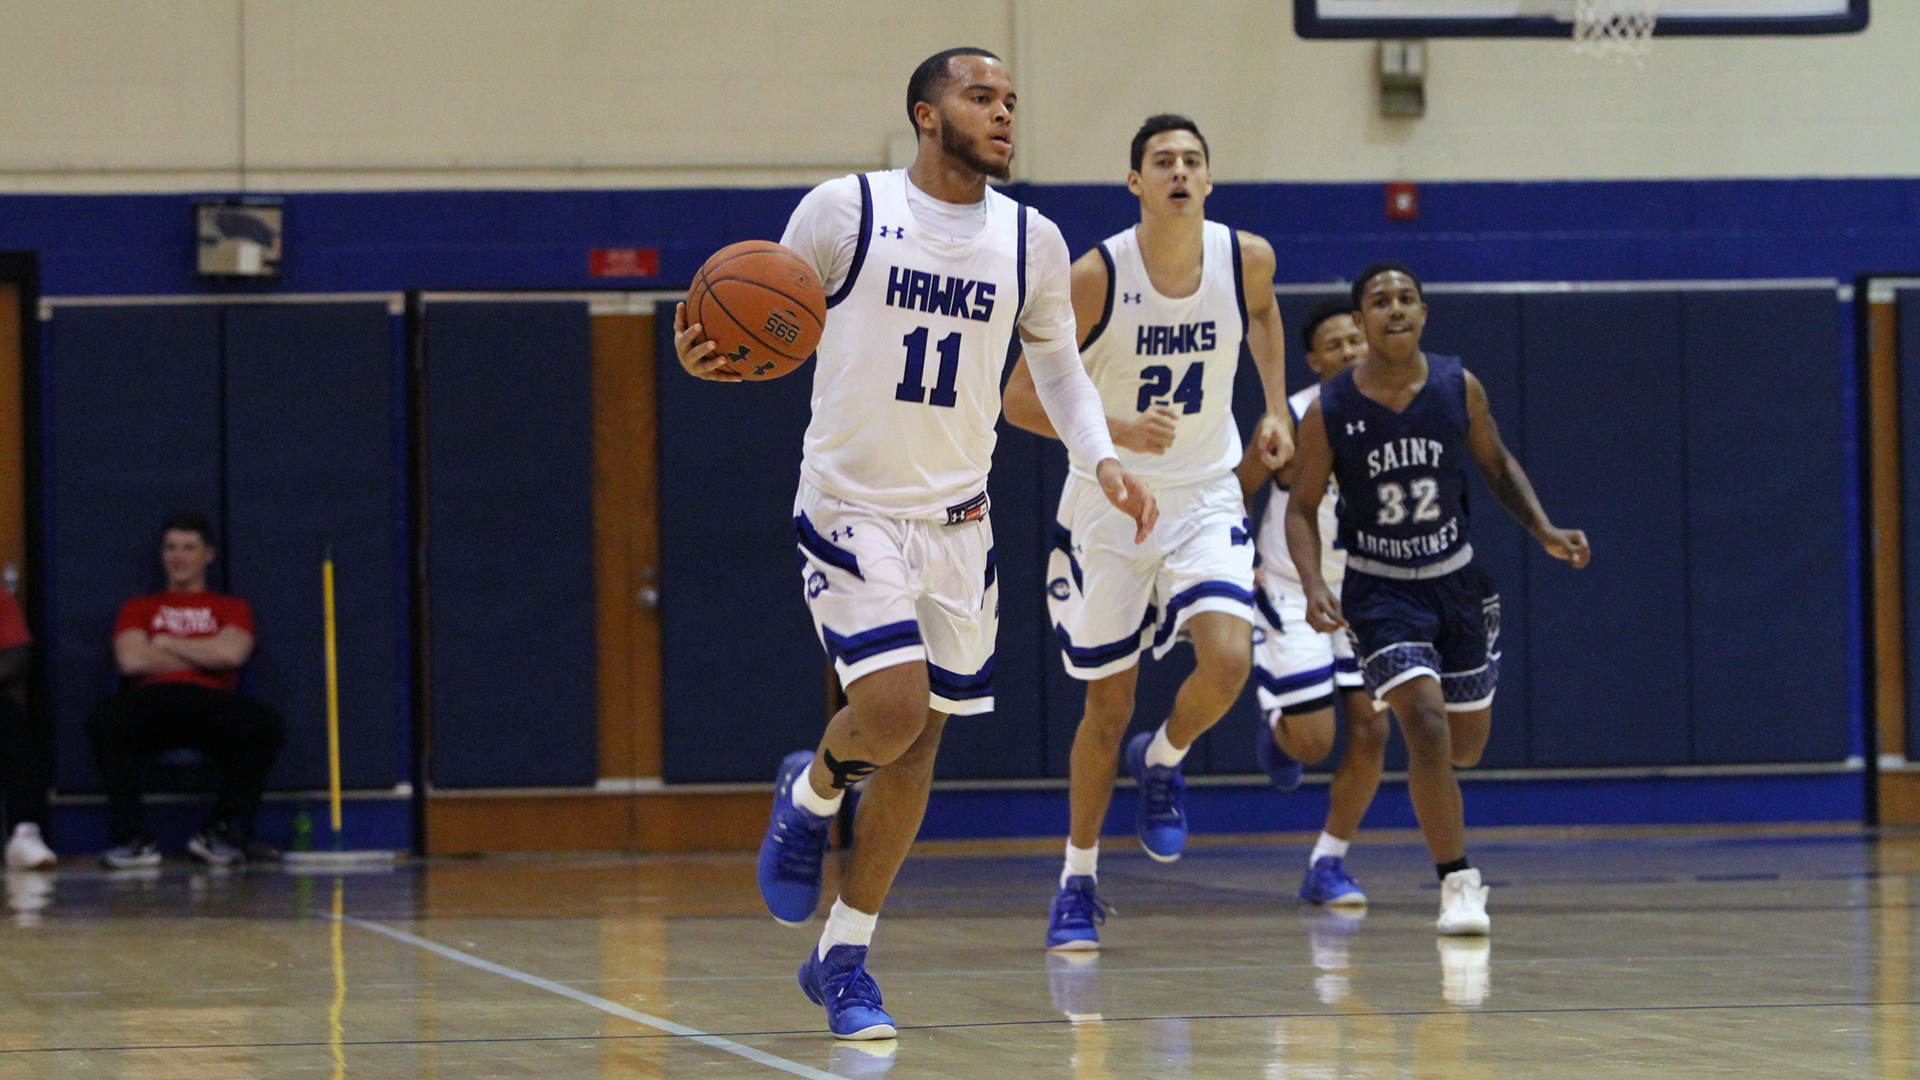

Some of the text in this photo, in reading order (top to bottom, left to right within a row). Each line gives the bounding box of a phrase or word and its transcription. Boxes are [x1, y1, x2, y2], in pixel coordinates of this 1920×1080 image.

[886, 266, 996, 322] HAWKS
[1136, 321, 1216, 355] HAWKS
[895, 326, 962, 408] 11
[1136, 362, 1205, 415] 24
[1367, 438, 1443, 479] SAINT
[1377, 477, 1441, 525] 32
